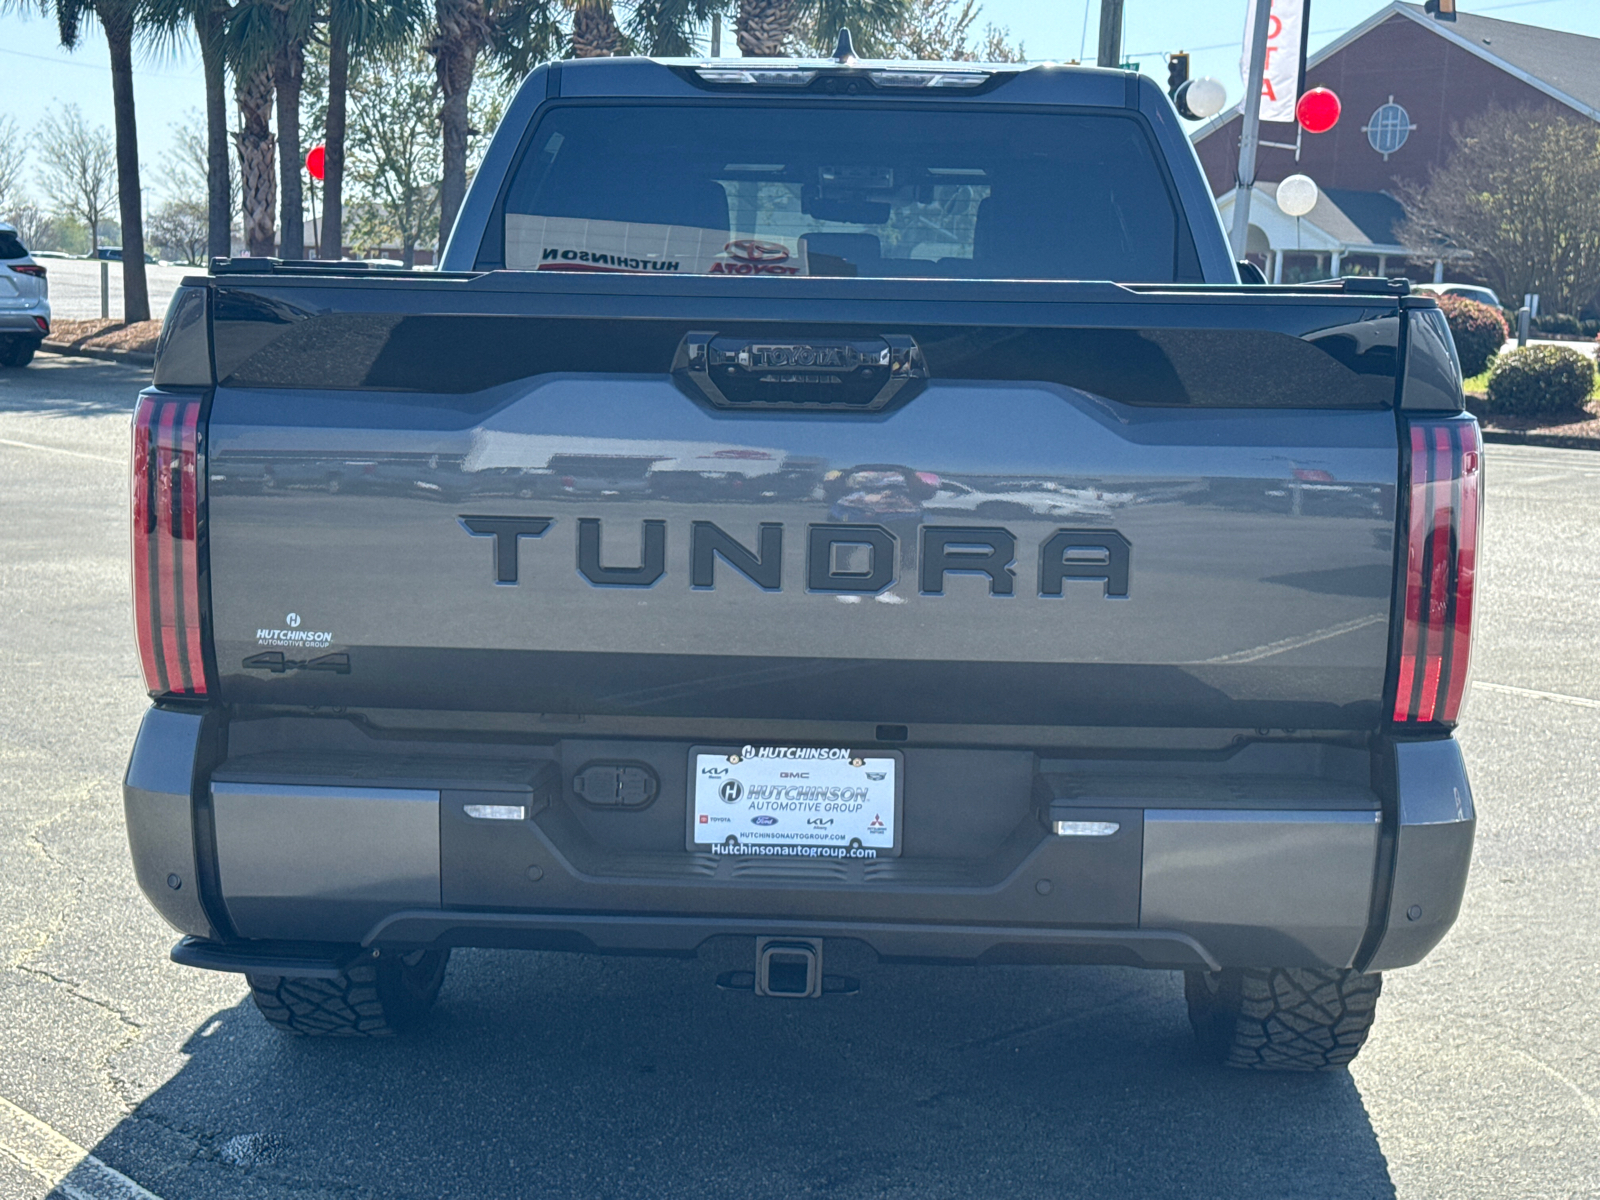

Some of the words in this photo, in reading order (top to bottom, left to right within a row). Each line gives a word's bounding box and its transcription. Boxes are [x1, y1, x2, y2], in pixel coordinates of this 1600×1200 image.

[1261, 0, 1282, 101] OTA
[758, 346, 841, 366] TOYOTA
[456, 514, 1132, 600] TUNDRA
[256, 628, 333, 642] HUTCHINSON
[258, 639, 303, 647] AUTOMOTIVE
[758, 746, 850, 760] HUTCHINSON
[780, 771, 810, 779] GMC
[747, 784, 868, 802] HUTCHINSON
[748, 801, 821, 811] AUTOMOTIVE
[824, 802, 863, 813] GROUP
[740, 832, 846, 841] HUTCHINSONAUTOGROUP.COM
[711, 843, 877, 858] Hutchinsonautogroup.com
